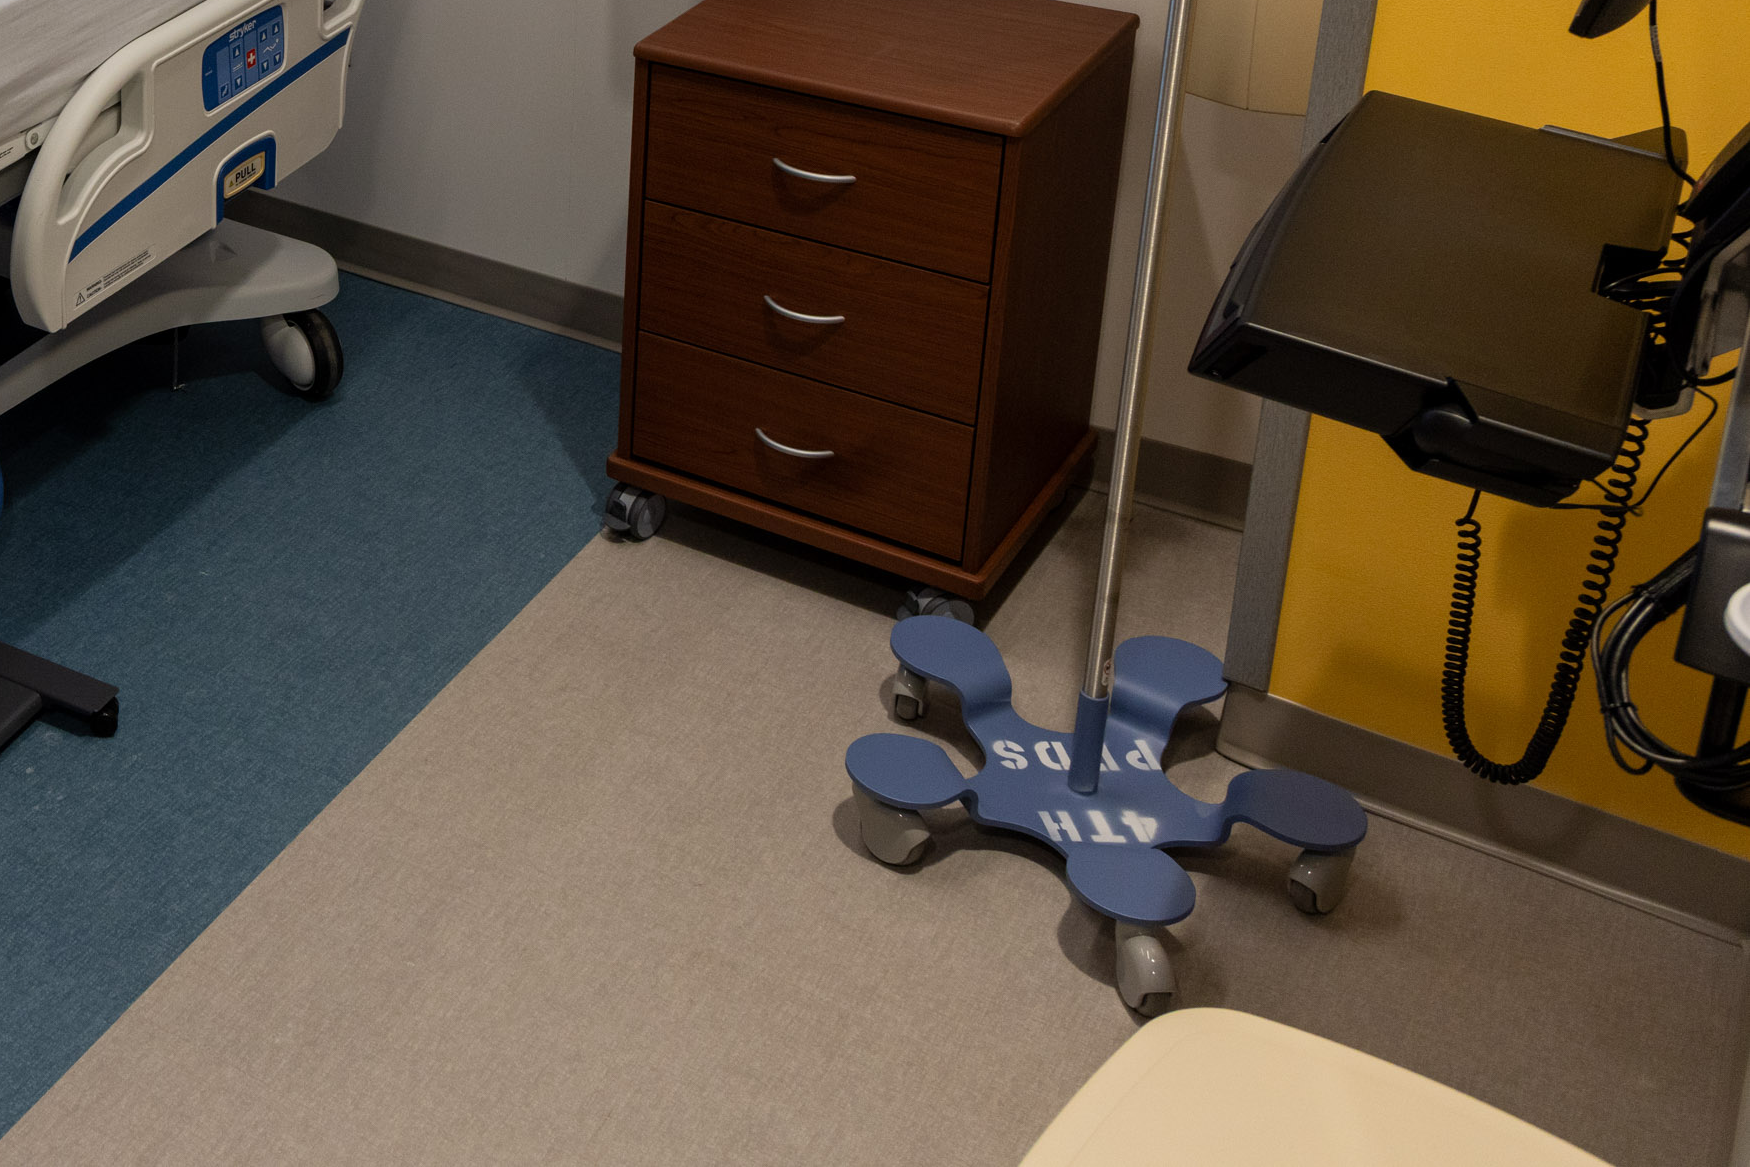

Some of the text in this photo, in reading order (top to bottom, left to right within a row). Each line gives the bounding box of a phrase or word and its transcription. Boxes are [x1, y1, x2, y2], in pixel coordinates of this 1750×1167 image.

[228, 19, 257, 43] stryker
[235, 162, 256, 183] PULL
[1037, 809, 1159, 843] 4TH
